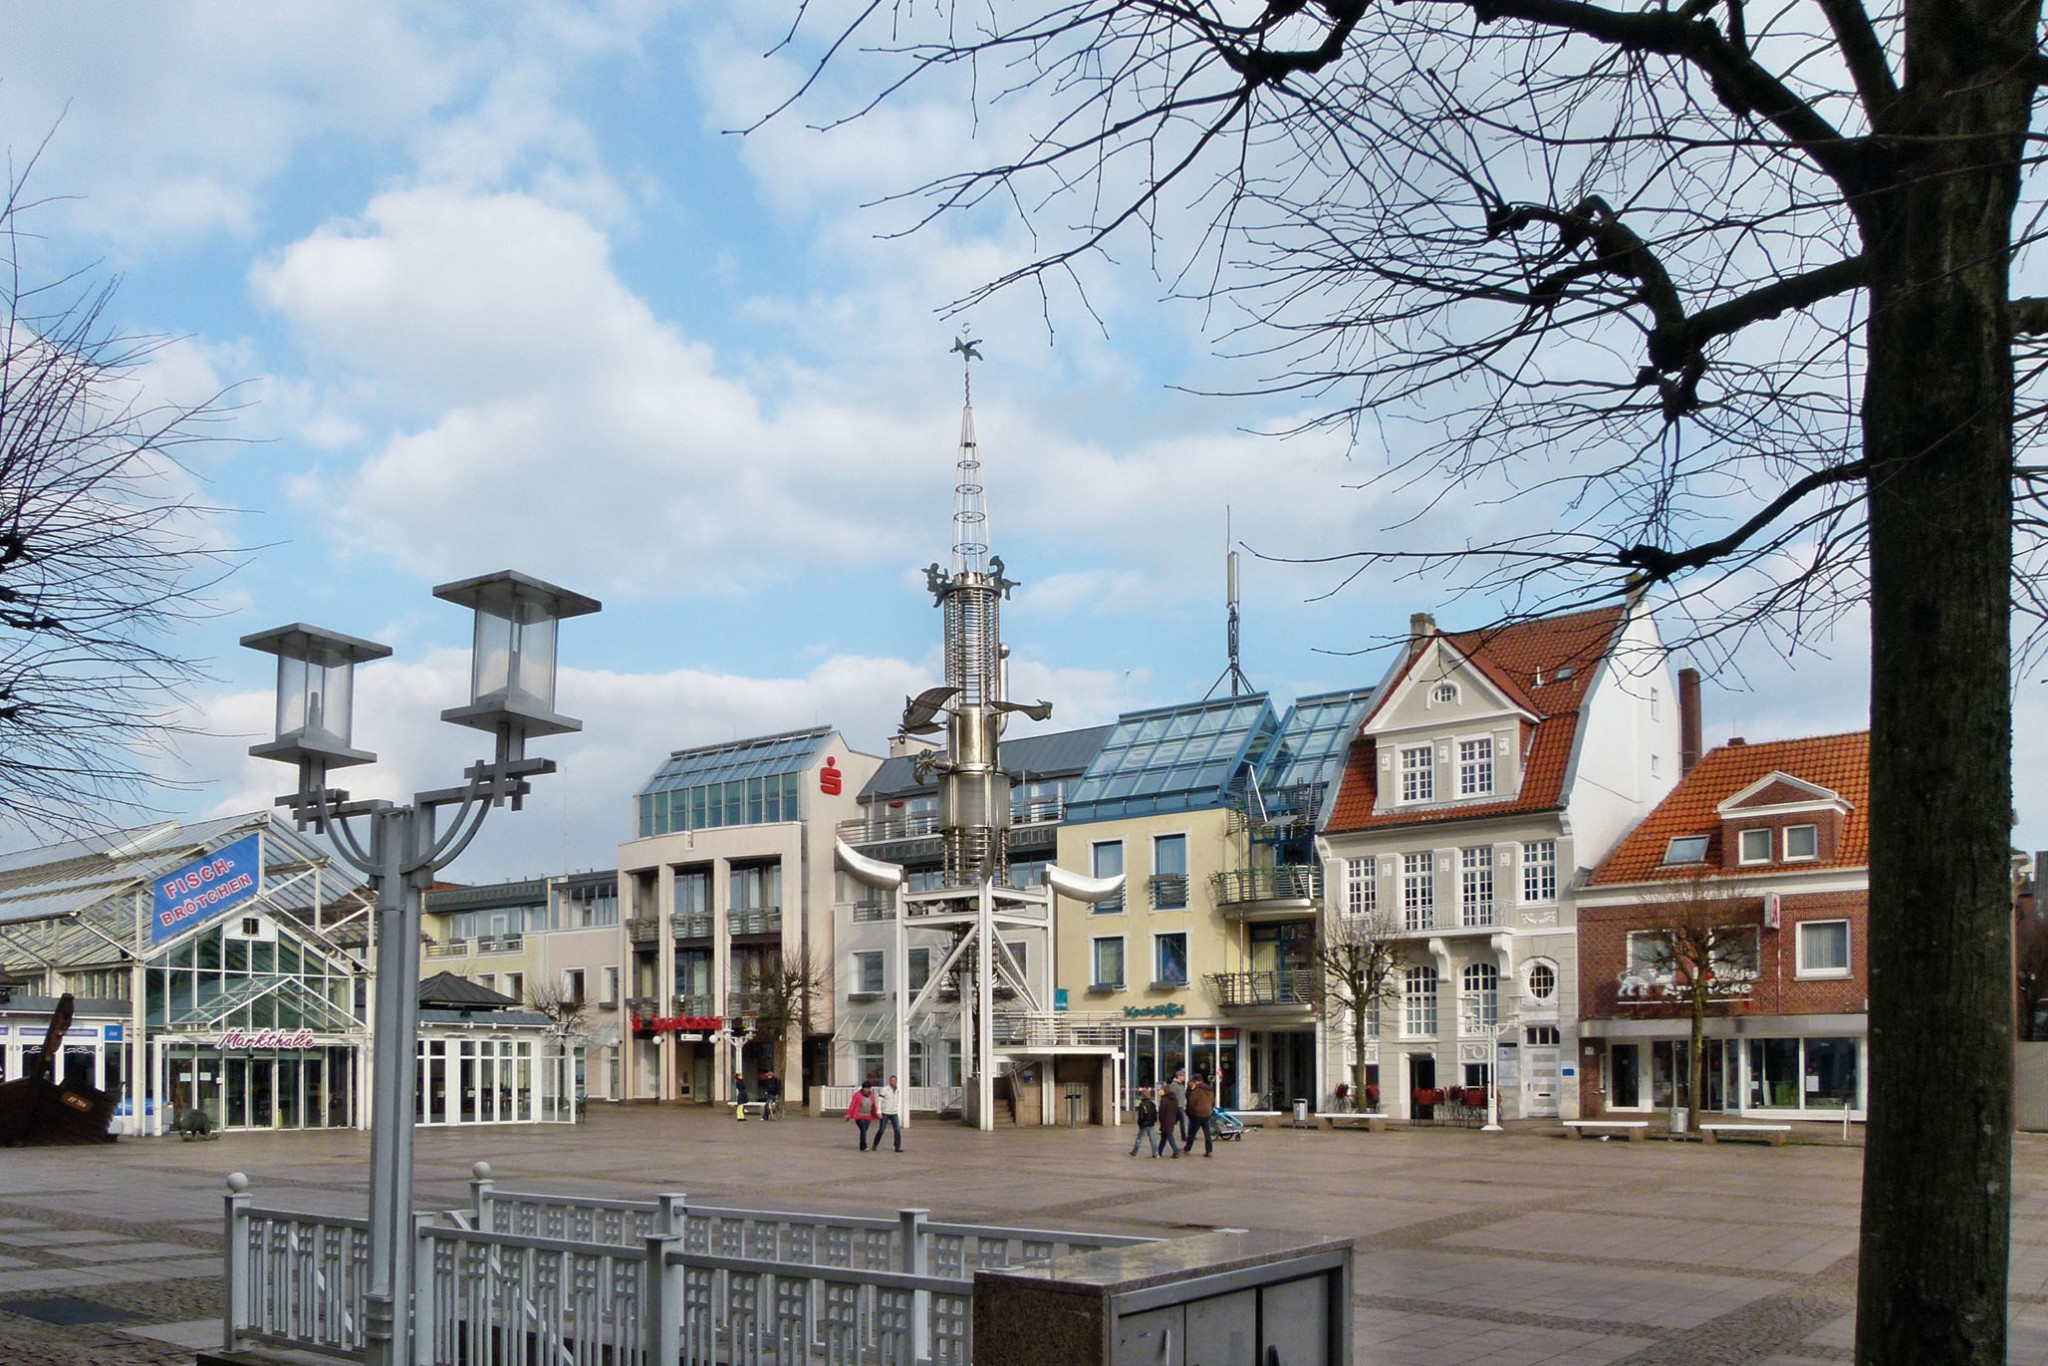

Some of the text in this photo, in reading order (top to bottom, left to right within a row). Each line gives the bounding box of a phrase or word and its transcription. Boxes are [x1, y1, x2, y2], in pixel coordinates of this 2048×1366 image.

[163, 858, 235, 899] FISCH-
[160, 873, 253, 927] BRÖTCHEN
[215, 1027, 316, 1049] Markthalle
